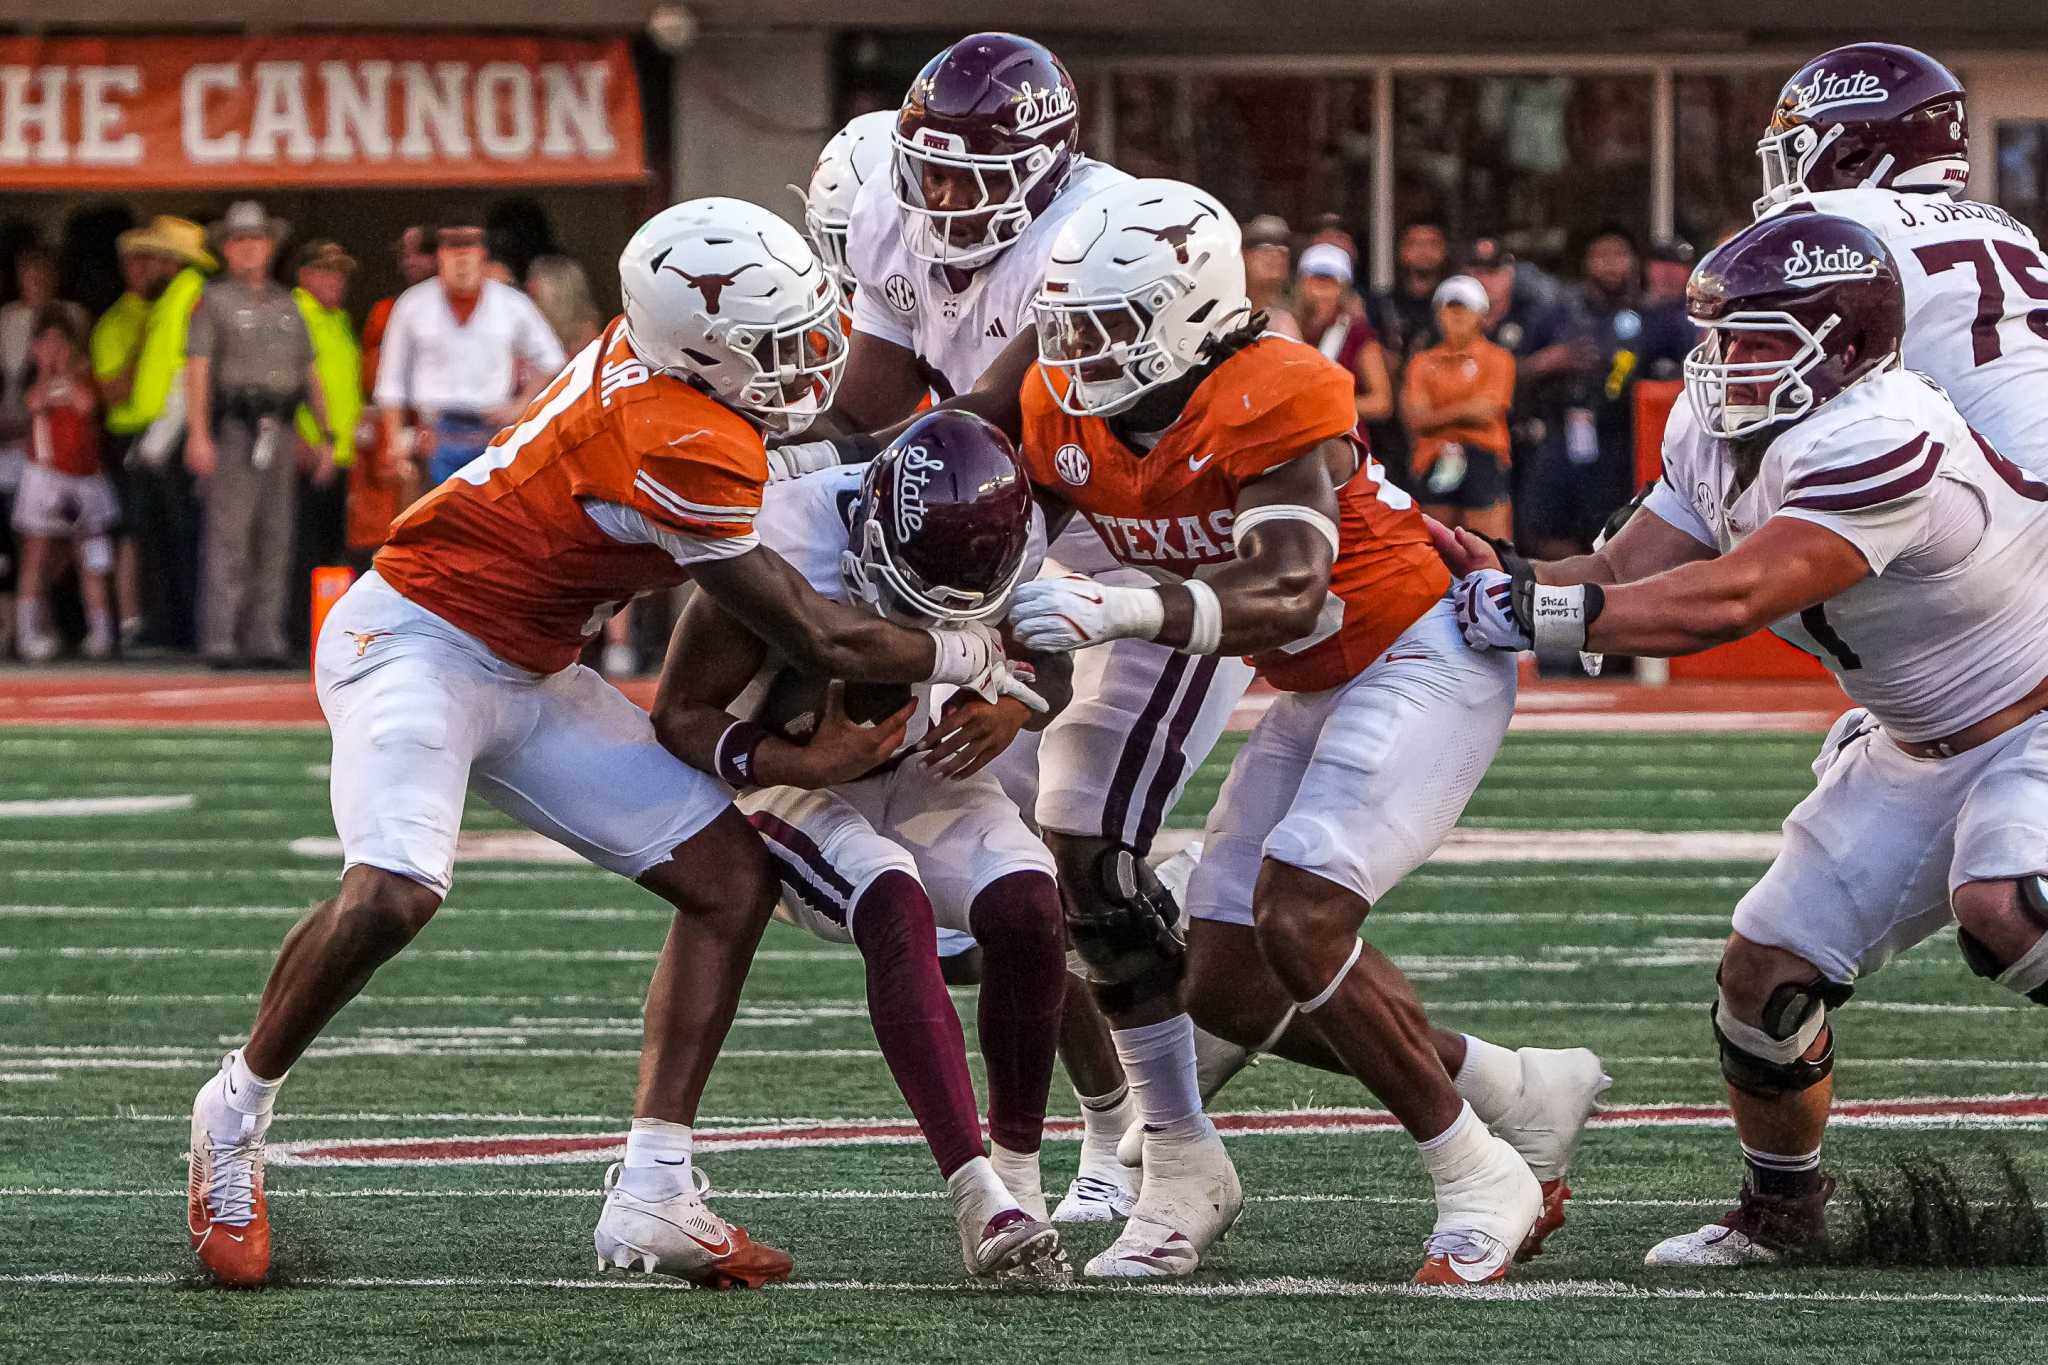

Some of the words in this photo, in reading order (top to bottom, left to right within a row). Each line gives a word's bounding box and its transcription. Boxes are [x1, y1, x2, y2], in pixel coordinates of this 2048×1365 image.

[181, 60, 616, 163] CANNON
[1014, 81, 1077, 138] State
[1788, 68, 1888, 118] State
[1783, 240, 1878, 288] State
[885, 274, 916, 312] SEC
[1055, 443, 1091, 486] SEC
[893, 444, 945, 543] State
[1092, 508, 1235, 560] TEXAS
